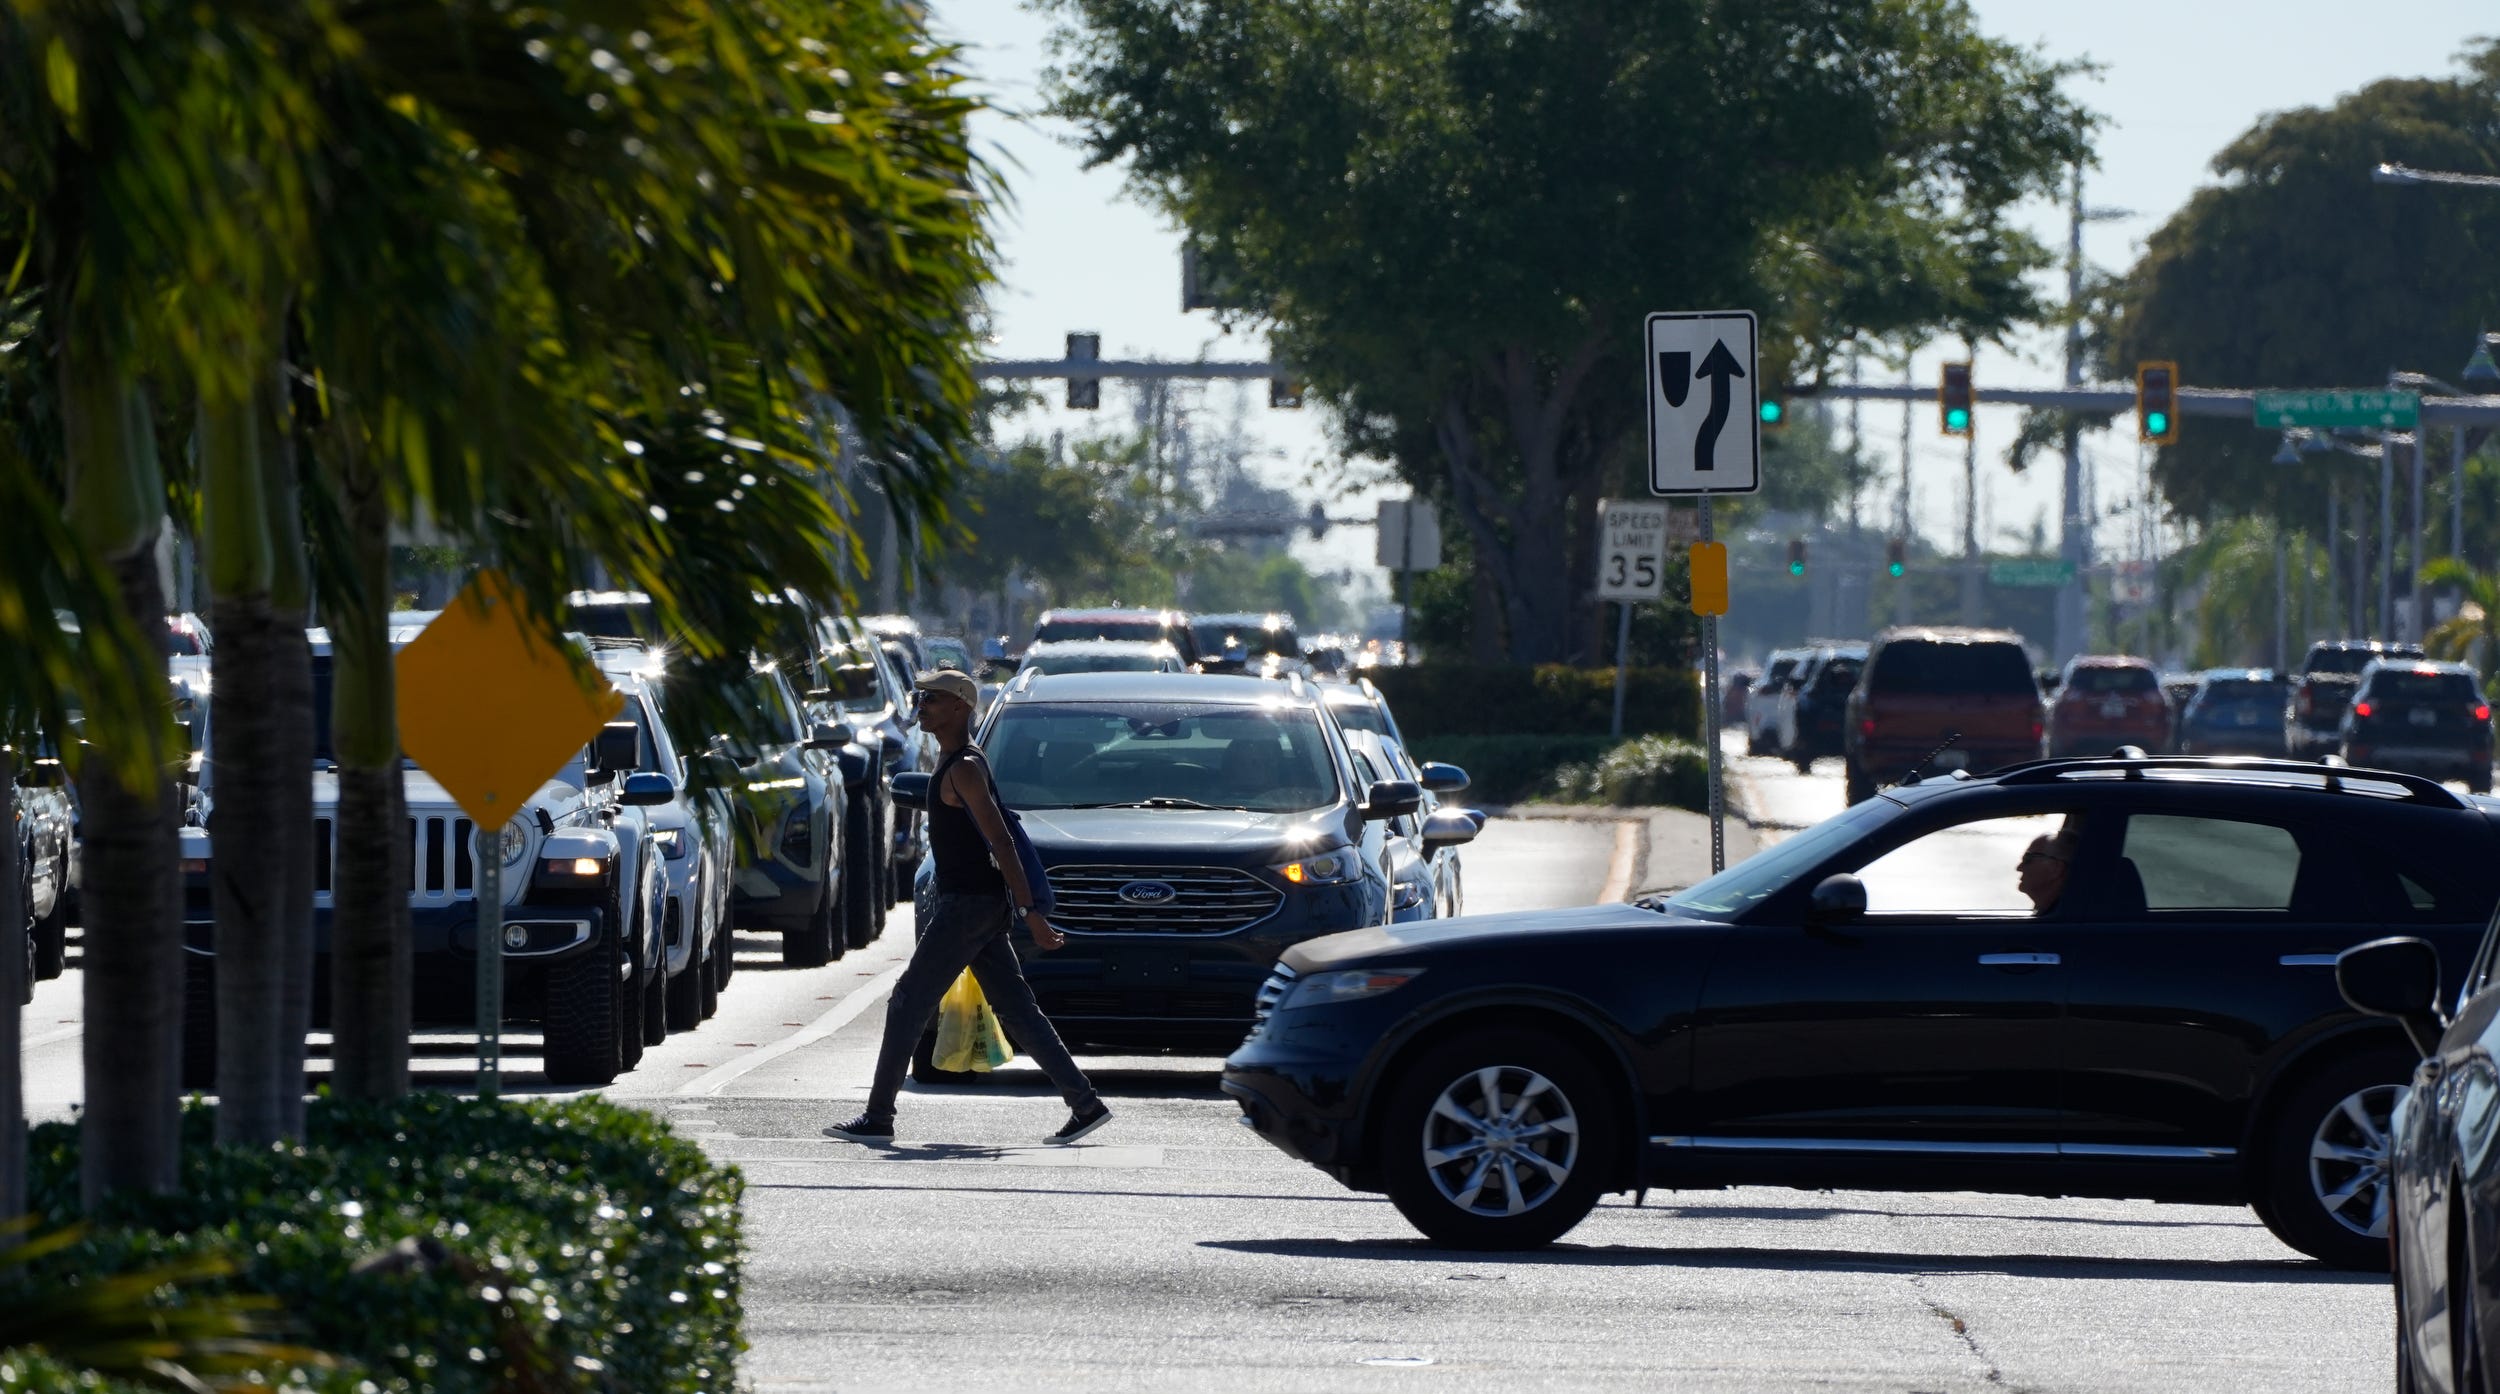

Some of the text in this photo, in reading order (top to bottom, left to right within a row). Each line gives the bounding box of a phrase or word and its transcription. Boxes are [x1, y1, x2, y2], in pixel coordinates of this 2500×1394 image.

[1609, 511, 1662, 529] SPEED
[1613, 532, 1656, 547] LIMIT
[1607, 555, 1656, 588] 35
[1132, 885, 1163, 899] Ford
